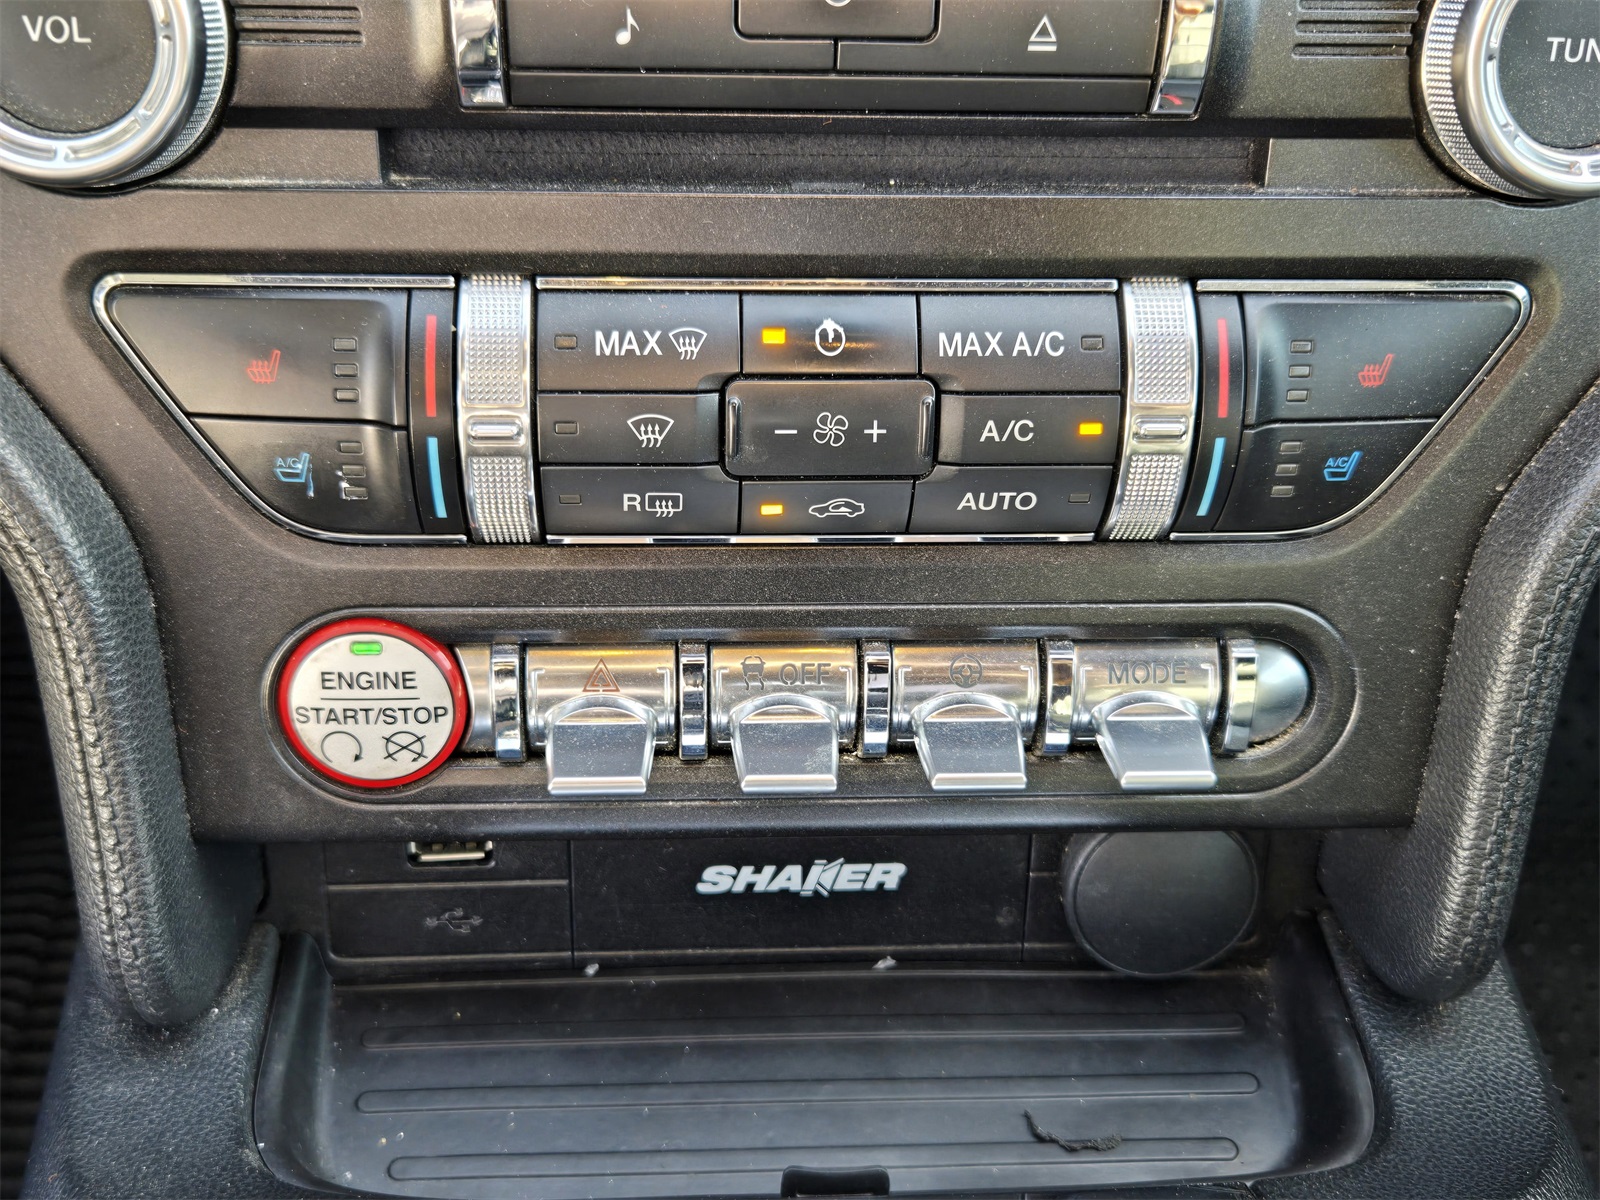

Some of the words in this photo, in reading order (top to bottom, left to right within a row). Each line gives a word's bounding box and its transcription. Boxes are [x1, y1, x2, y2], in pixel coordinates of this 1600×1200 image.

[22, 15, 91, 44] VOL
[594, 331, 662, 357] MAX
[938, 332, 1004, 357] MAX
[1012, 331, 1065, 359] A/C
[980, 419, 1035, 444] A/C
[276, 457, 302, 468] A/C
[1325, 457, 1349, 468] A/C
[622, 493, 642, 513] R
[957, 492, 1038, 512] AUTO
[320, 671, 418, 690] ENGINE
[779, 662, 831, 685] OFF
[1107, 662, 1188, 685] MODE
[294, 706, 449, 725] START/STOP
[695, 858, 907, 898] SHAKER
